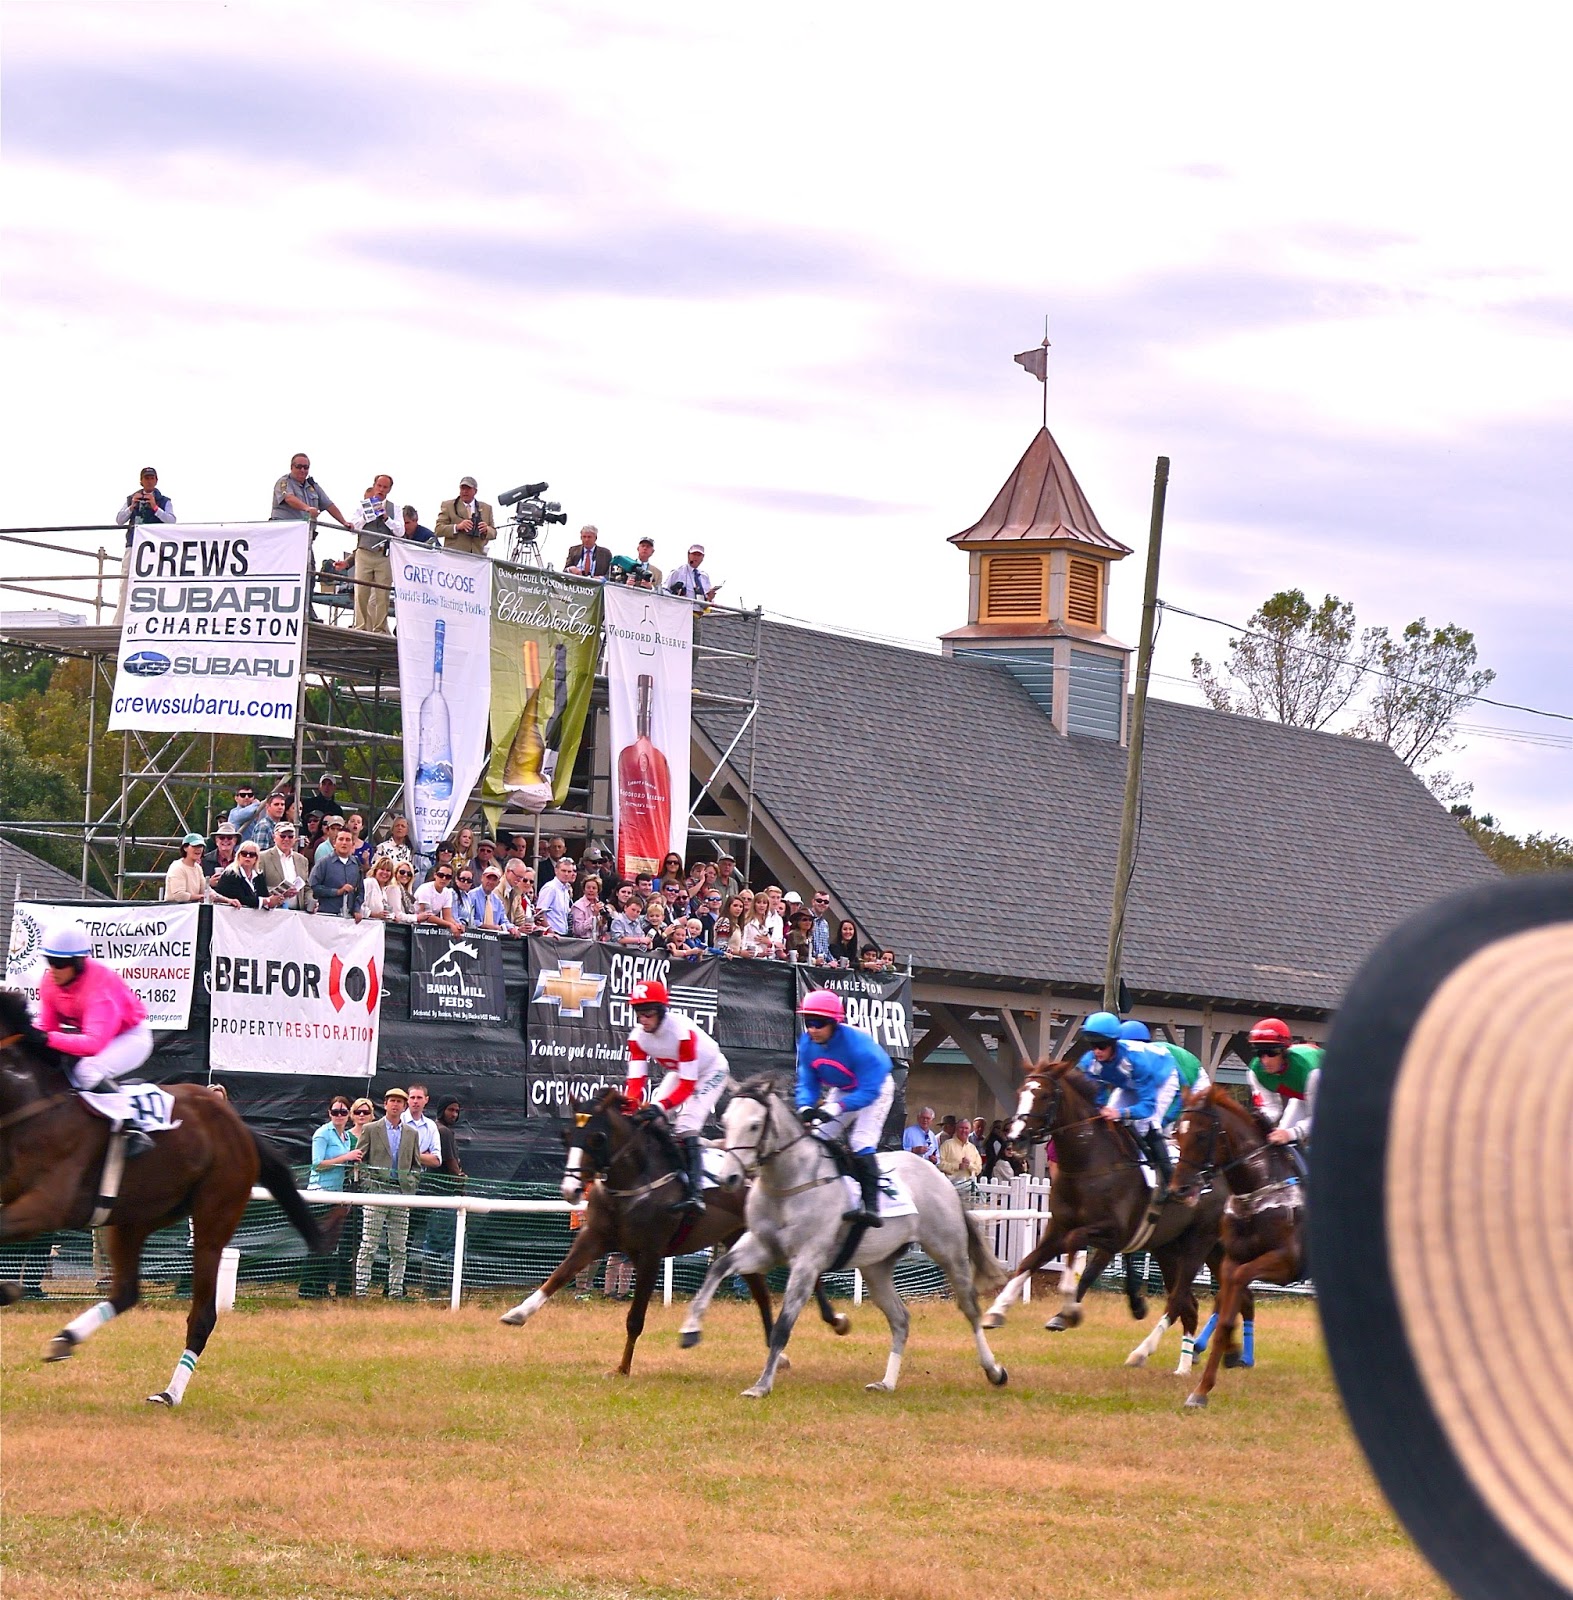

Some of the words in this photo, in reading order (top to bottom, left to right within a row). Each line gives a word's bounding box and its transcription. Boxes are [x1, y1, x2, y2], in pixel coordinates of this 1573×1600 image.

[135, 539, 249, 577] CREWS
[404, 565, 434, 585] GREY
[437, 571, 476, 594] GOOSE
[513, 572, 539, 584] MIGUEL
[130, 586, 301, 613] SUBARU
[127, 622, 139, 635] of
[145, 617, 299, 637] CHARLESTON
[497, 588, 569, 632] Charleston
[566, 603, 596, 644] Cup
[655, 632, 687, 649] RESERVE
[172, 656, 294, 678] SUBARU
[115, 693, 293, 720] crewssubaru.com
[76, 919, 168, 937] TRICKLAND
[108, 941, 191, 959] INSURANCE
[122, 967, 191, 980] INSURANCE
[215, 956, 321, 998] BELFOR
[610, 953, 671, 995] CREWS
[426, 984, 459, 995] BANKS
[460, 986, 486, 998] MILL
[824, 979, 883, 995] CHARLESTON
[439, 996, 474, 1009] FEEDS
[846, 996, 910, 1048] PAPER
[530, 1039, 566, 1057] You've
[568, 1043, 586, 1062] got
[587, 1047, 593, 1059] a
[595, 1043, 622, 1061] friend
